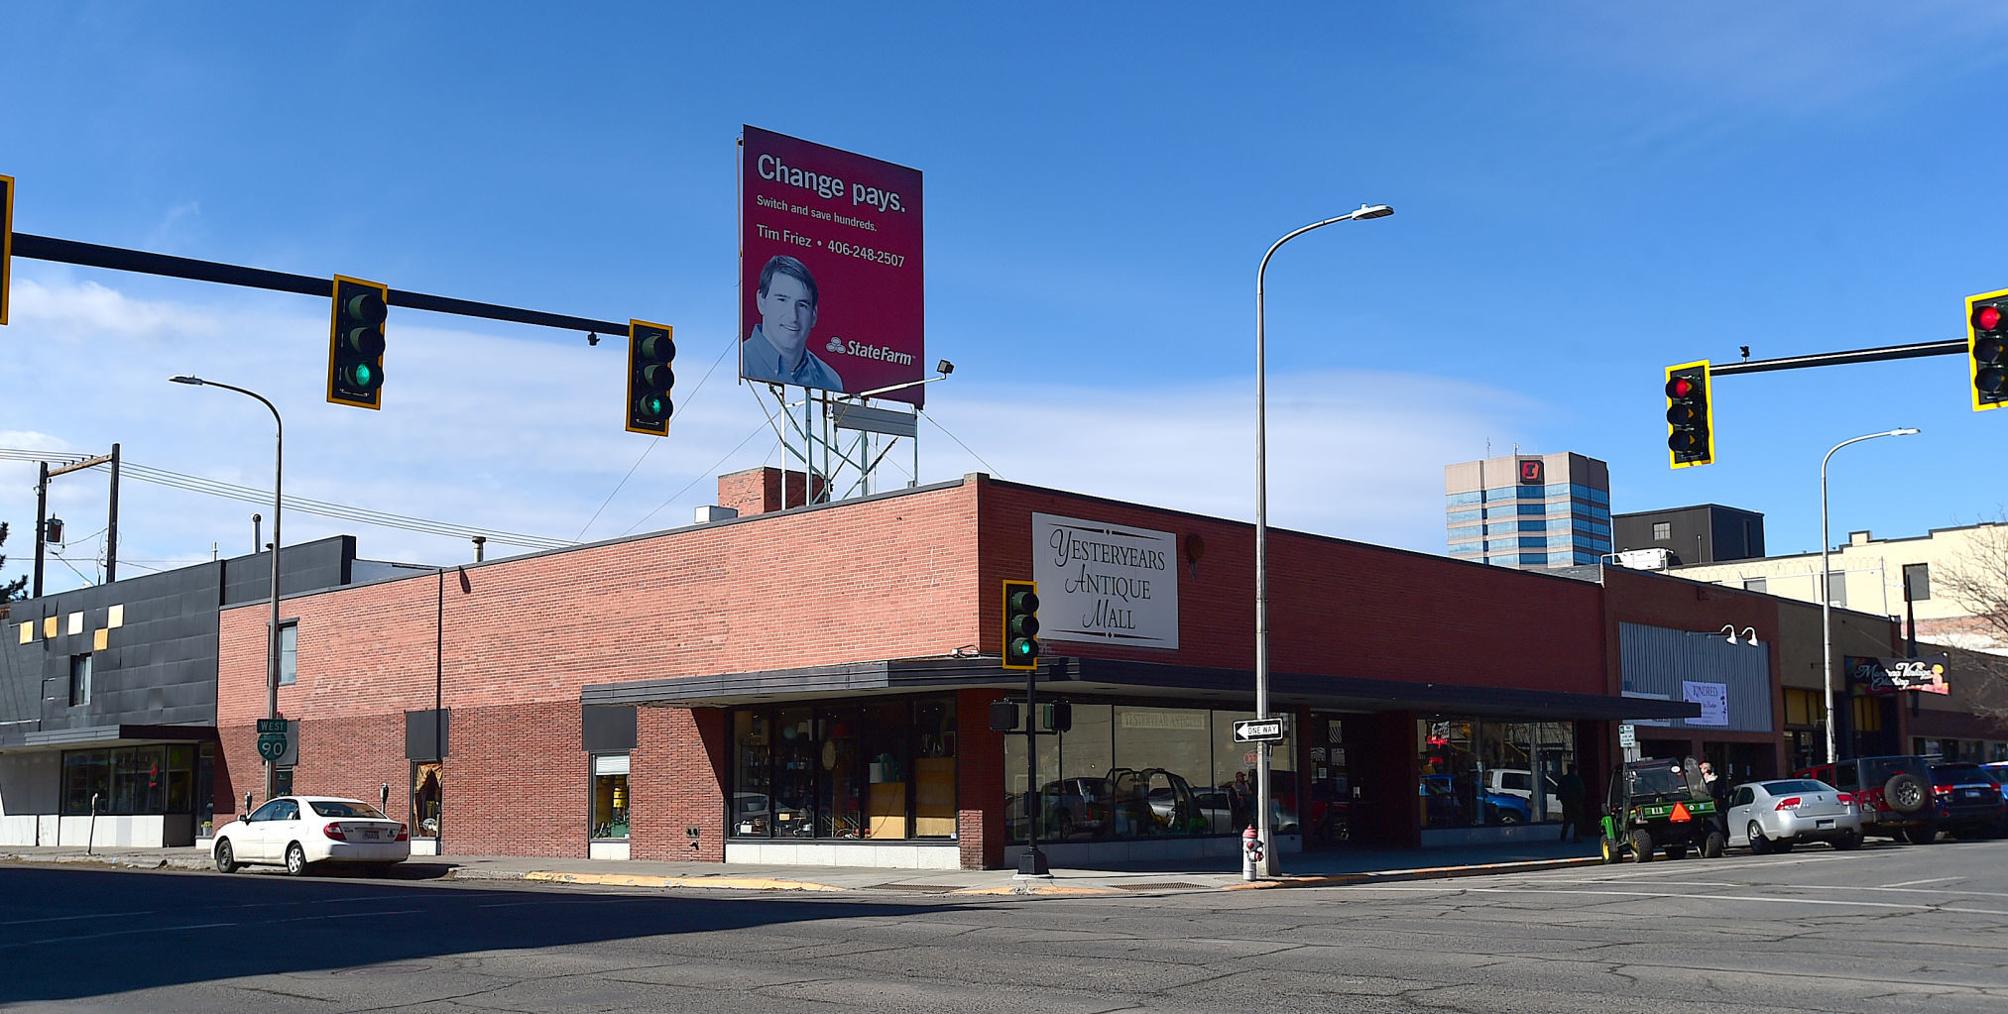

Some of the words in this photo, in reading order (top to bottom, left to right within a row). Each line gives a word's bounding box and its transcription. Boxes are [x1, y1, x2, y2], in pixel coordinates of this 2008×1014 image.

[756, 153, 845, 199] Change
[852, 182, 906, 213] pays.
[756, 194, 789, 212] Switch
[790, 203, 809, 216] and
[810, 208, 832, 222] save
[833, 212, 878, 232] hundreds.
[756, 224, 780, 241] Tim
[783, 229, 812, 248] Friez
[827, 239, 905, 268] 406-248-2507
[846, 340, 912, 366] StateFarm
[1049, 528, 1166, 571] YESTERYEARS
[1064, 563, 1151, 603] ANTIQUE
[1082, 599, 1136, 630] MALL
[260, 721, 285, 731] WEST
[1247, 726, 1261, 735] ONE
[1262, 725, 1277, 733] WAY
[261, 742, 283, 756] 90
